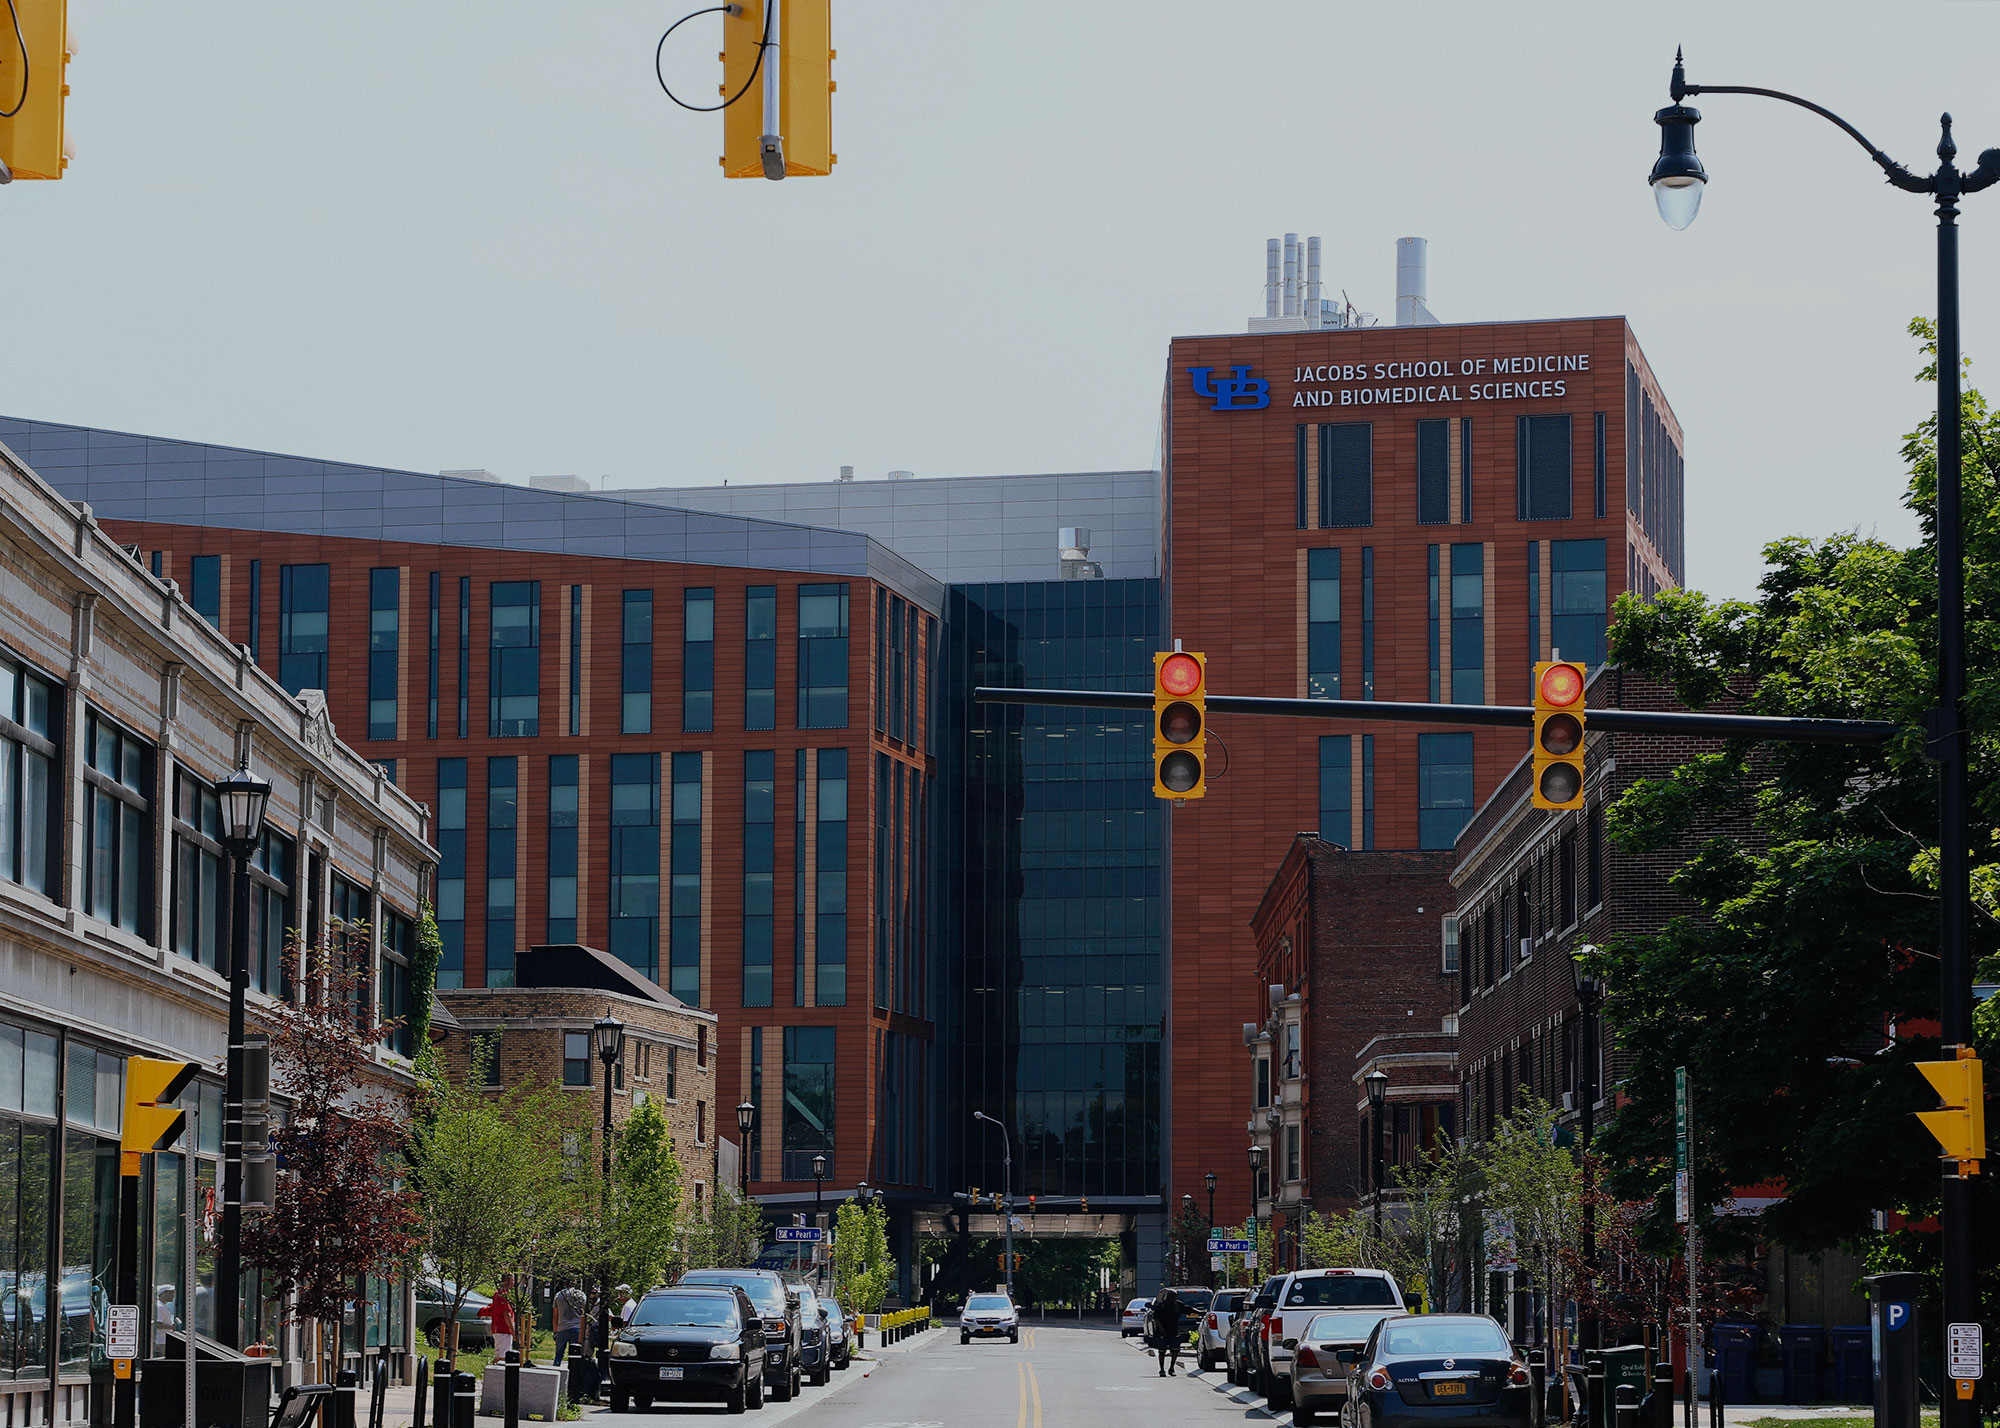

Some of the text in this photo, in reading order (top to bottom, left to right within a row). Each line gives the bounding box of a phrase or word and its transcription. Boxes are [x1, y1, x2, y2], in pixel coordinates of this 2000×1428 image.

[1293, 354, 1590, 383] JACOBS SCHOOL OF MEDICINE
[1292, 380, 1566, 408] AND BIOMEDICAL SCIENCES
[795, 1230, 812, 1239] Pearl
[1225, 1242, 1240, 1250] Pearl
[1890, 1305, 1904, 1326] P
